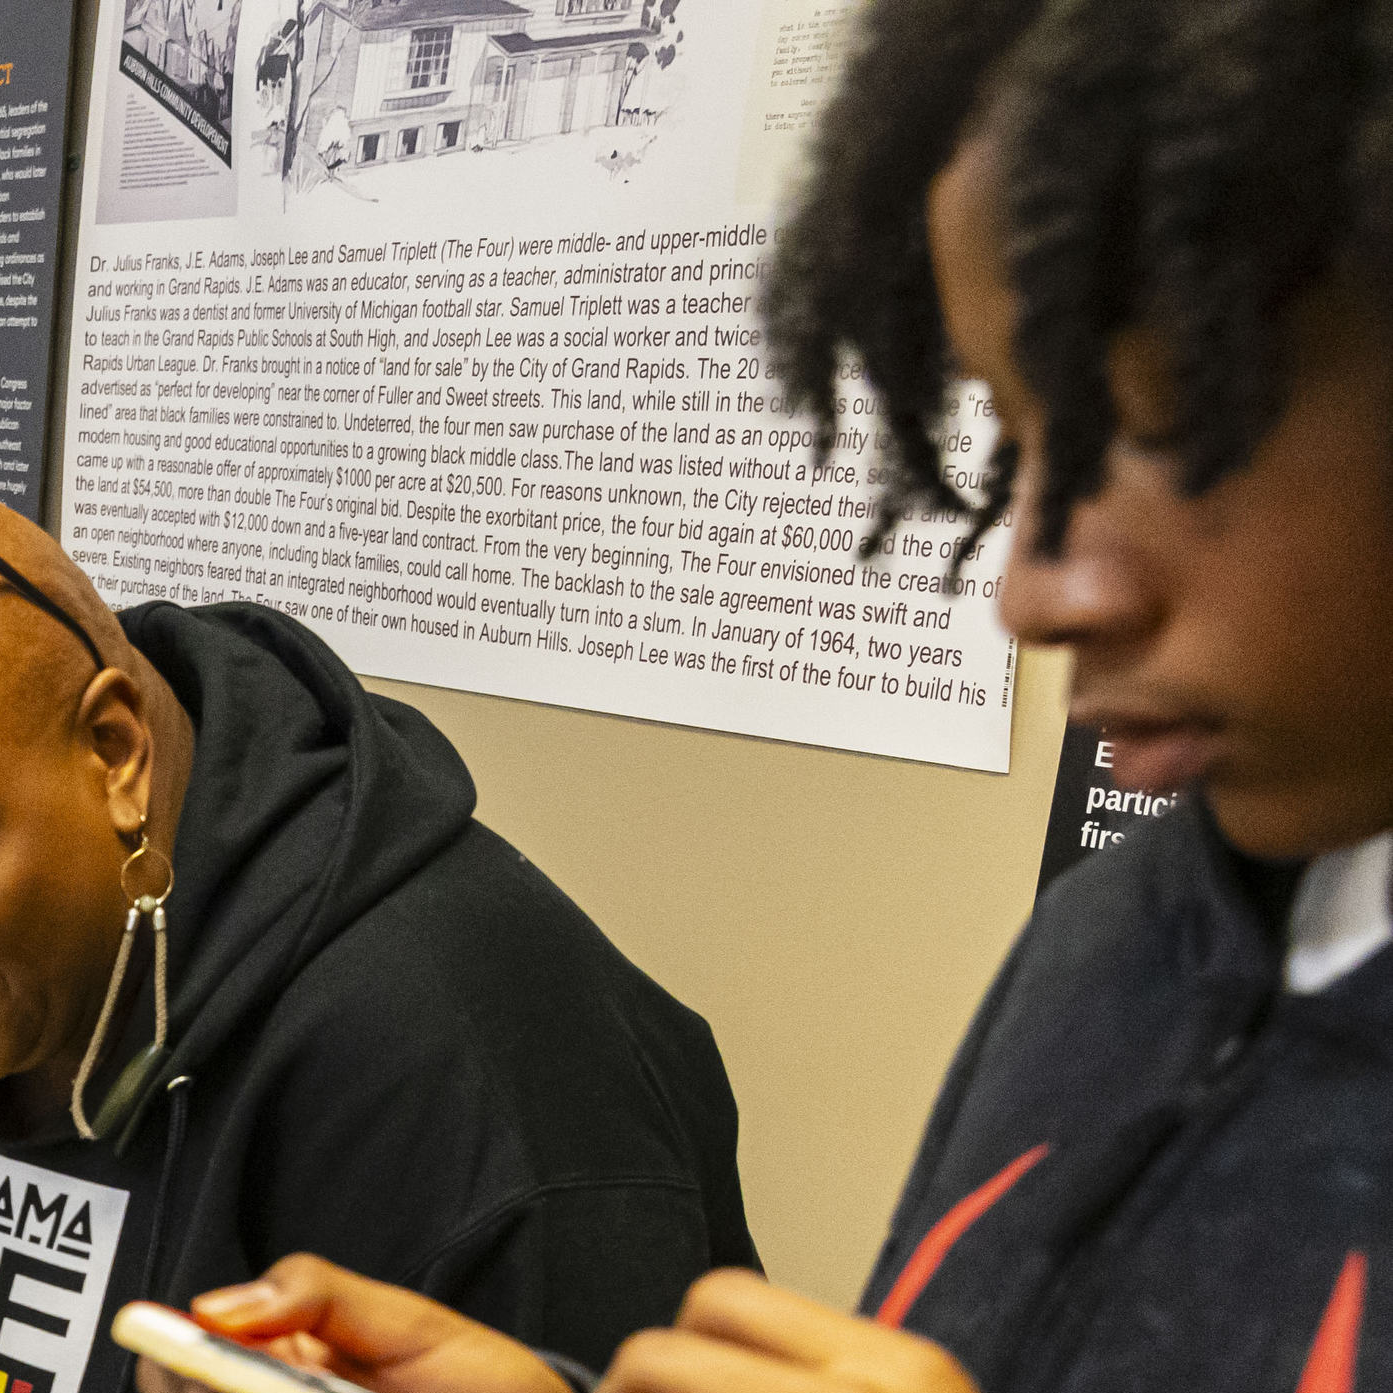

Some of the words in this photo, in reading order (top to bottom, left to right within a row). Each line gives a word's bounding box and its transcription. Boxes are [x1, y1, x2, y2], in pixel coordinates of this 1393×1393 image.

[123, 54, 148, 82] AUBURN
[145, 71, 162, 94] HILLS
[159, 82, 193, 121] COMMUNITY
[90, 256, 109, 272] Dr.
[113, 256, 142, 272] Julius
[146, 254, 181, 270] Franks,
[185, 251, 205, 269] J.E.
[209, 251, 247, 268] Adams,
[250, 248, 286, 270] Joseph
[288, 248, 309, 265] Lee
[312, 245, 334, 264] and
[338, 243, 387, 263] Samuel
[392, 241, 437, 265] Triplett
[441, 239, 473, 263] (The
[477, 237, 514, 261] Four)
[519, 240, 553, 255] were
[557, 232, 611, 254] middle-
[616, 229, 646, 251] and
[651, 224, 767, 255] upper-middle
[81, 380, 137, 396] advertised
[140, 384, 151, 396] as
[155, 380, 192, 400] “perfect
[196, 381, 210, 398] for
[213, 382, 275, 404] developing”
[278, 387, 301, 401] near
[304, 385, 320, 402] the
[323, 389, 360, 403] corner
[363, 385, 375, 403] of
[378, 385, 414, 404] Fuller
[416, 387, 442, 405] and
[446, 387, 488, 407] Sweet
[492, 389, 544, 408] streets.
[551, 388, 582, 409] This
[587, 389, 625, 413] land,
[632, 390, 676, 411] while
[682, 391, 710, 411] still
[716, 391, 730, 412] in
[737, 391, 765, 413] the
[73, 526, 87, 538] an
[91, 528, 115, 543] open
[118, 530, 184, 549] neighborhood
[188, 536, 218, 553] where
[222, 542, 264, 560] anyone,
[269, 544, 318, 569] including
[322, 548, 351, 568] black
[355, 551, 402, 576] families,
[407, 559, 441, 578] could
[445, 562, 468, 581] call
[472, 563, 514, 586] home.
[521, 567, 549, 589] The
[555, 571, 624, 596] backlash
[630, 579, 644, 599] to
[650, 580, 675, 602] the
[680, 584, 714, 606] sale
[719, 592, 813, 616] agreement
[819, 601, 856, 620] was
[862, 602, 908, 626] swift
[913, 607, 951, 630] and
